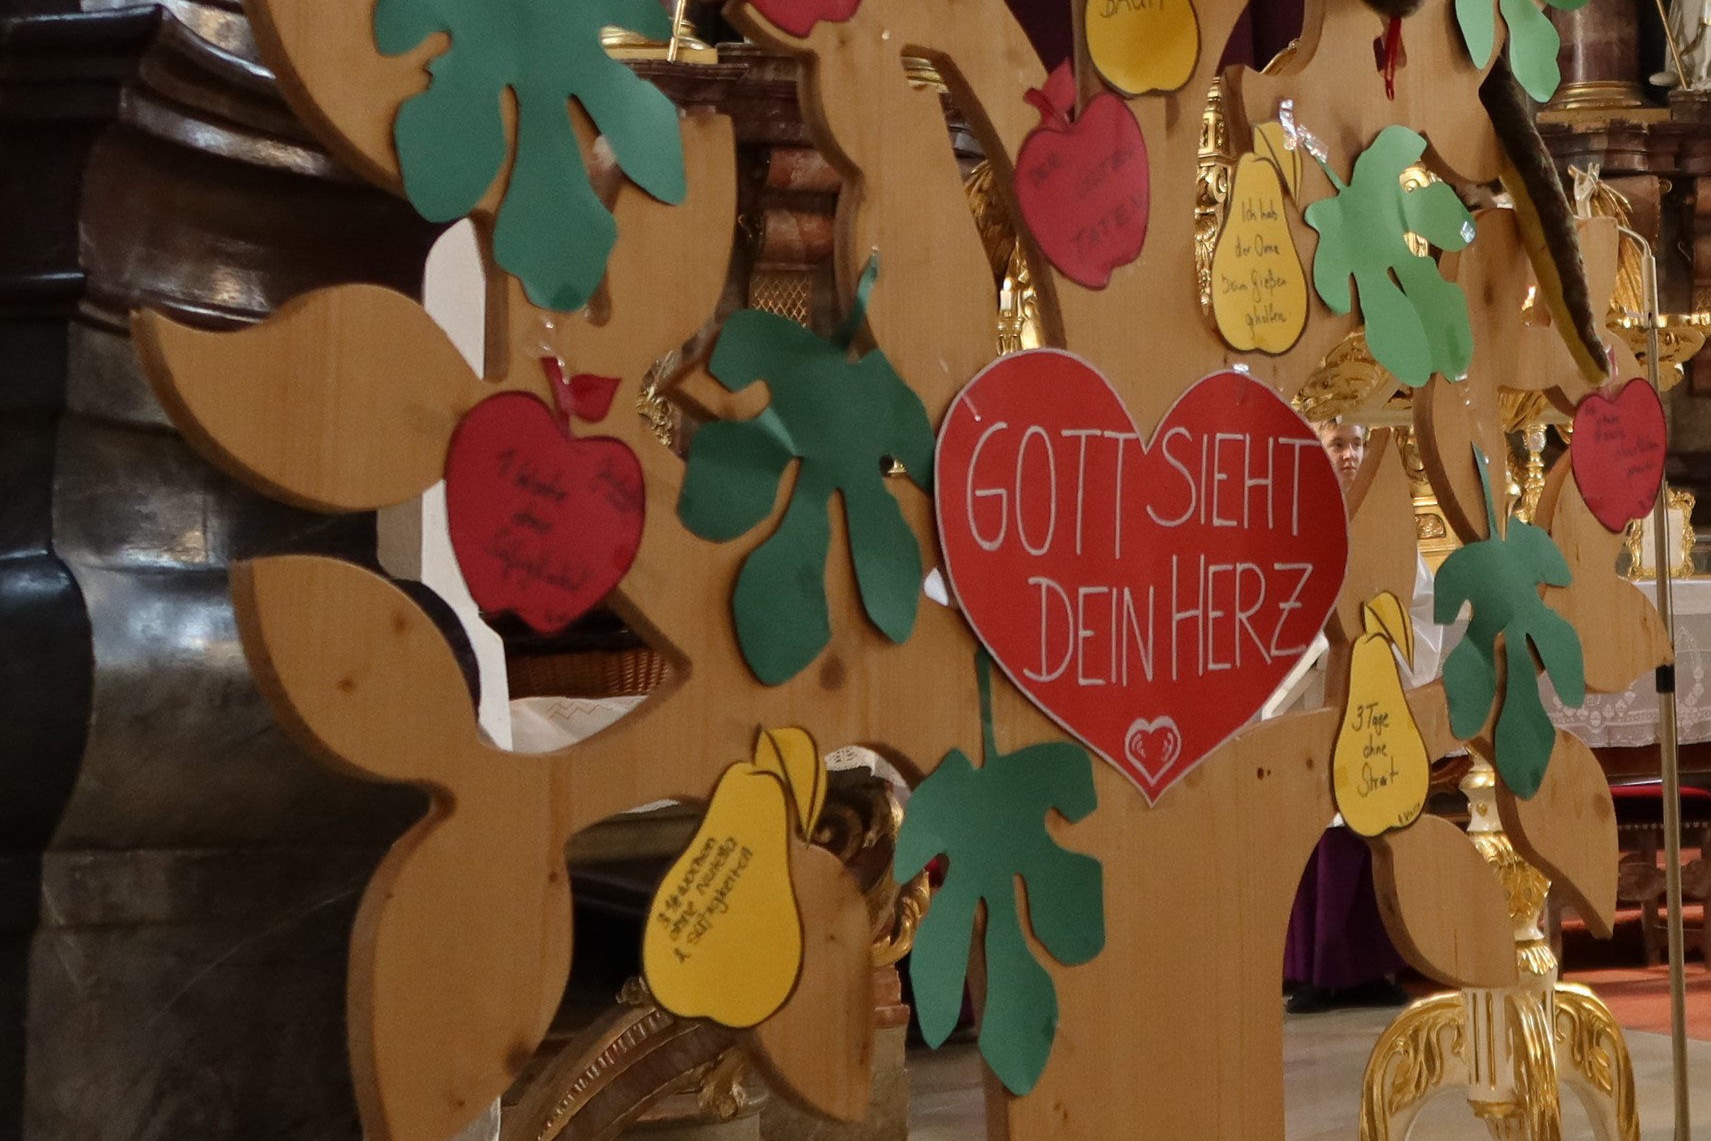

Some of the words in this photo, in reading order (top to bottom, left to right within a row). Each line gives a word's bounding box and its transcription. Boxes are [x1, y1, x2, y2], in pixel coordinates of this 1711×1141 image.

[1241, 197, 1257, 222] Ich
[1235, 235, 1252, 257] der
[967, 422, 1137, 559] GOTT
[1147, 427, 1321, 537] SIEHT
[1023, 577, 1154, 687] DEIN
[1171, 554, 1314, 680] HERZ
[1352, 705, 1363, 732] 3
[1366, 702, 1390, 736] Tage
[1362, 734, 1388, 759] ohne
